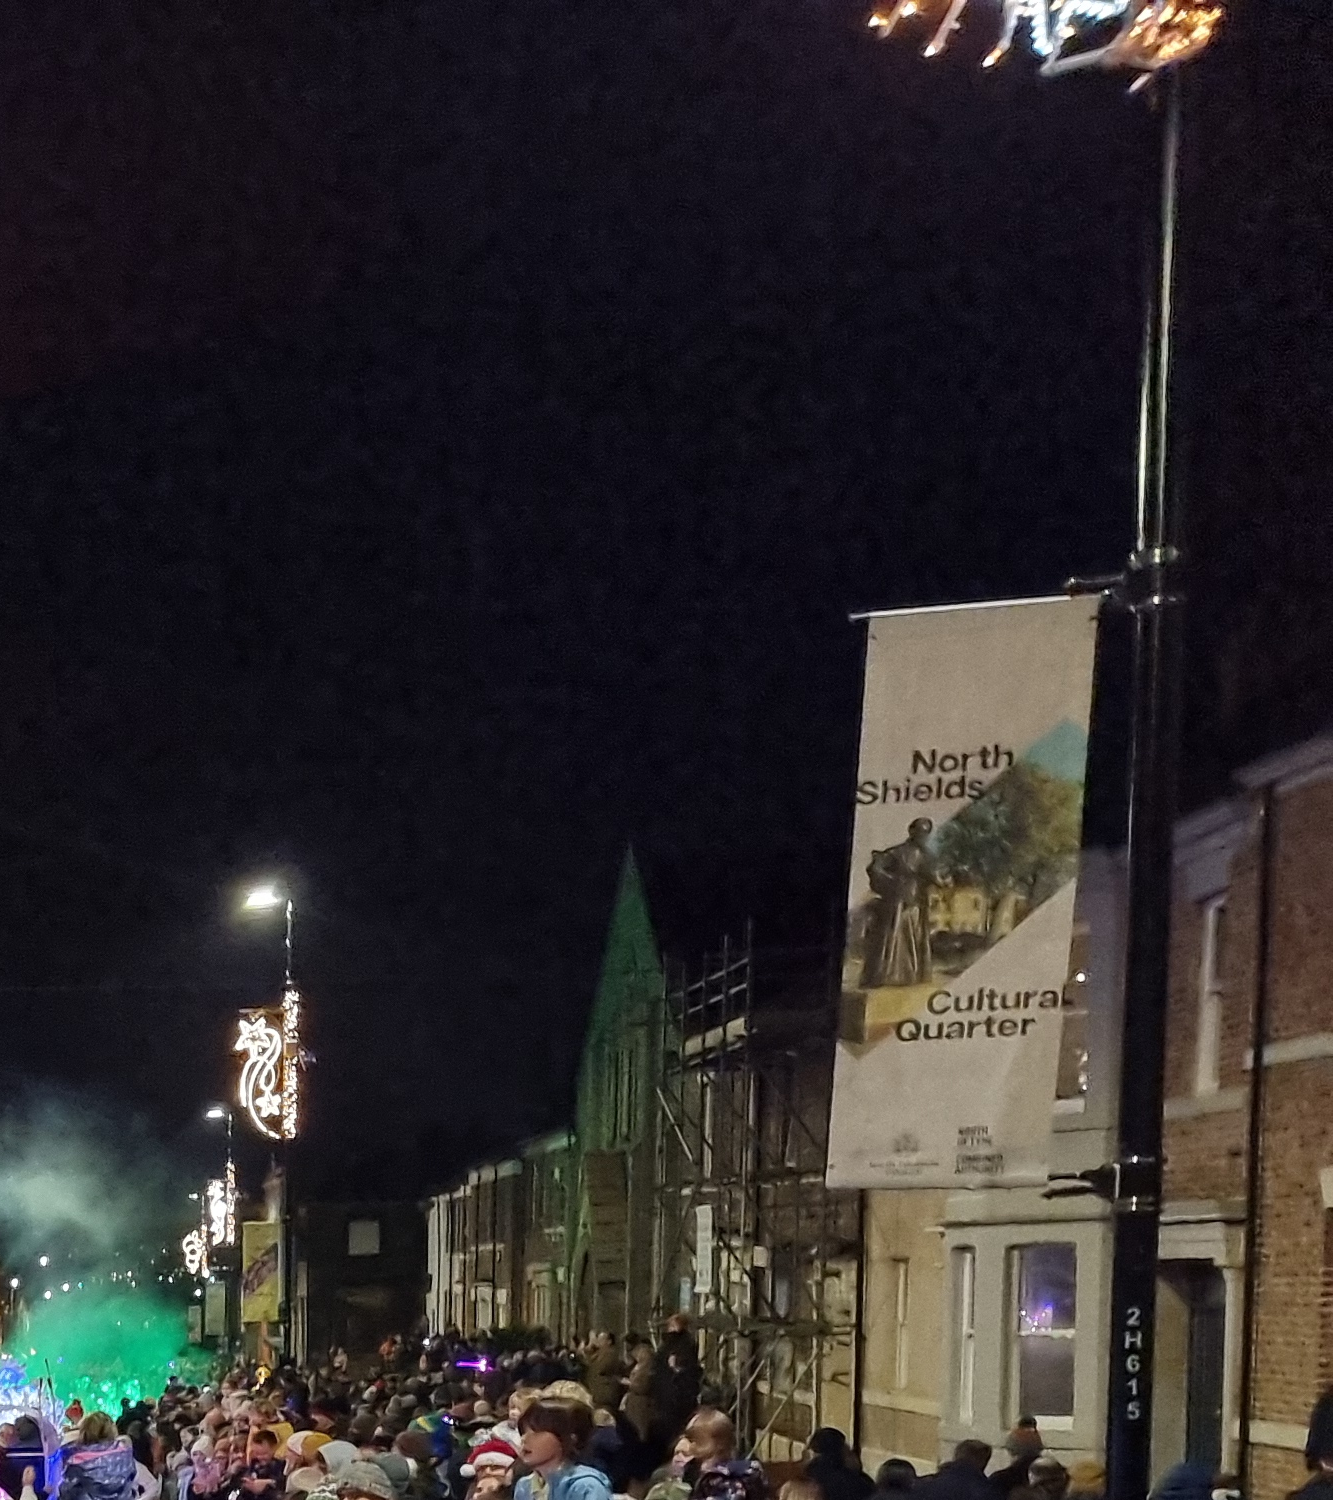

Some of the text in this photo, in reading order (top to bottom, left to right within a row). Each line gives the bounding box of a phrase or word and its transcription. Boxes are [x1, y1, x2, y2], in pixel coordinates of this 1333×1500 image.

[911, 744, 1014, 775] North
[856, 775, 985, 805] Shields
[926, 984, 1073, 1016] Cultural
[895, 1015, 1036, 1042] Quarter
[1124, 1306, 1143, 1421] 2H615
